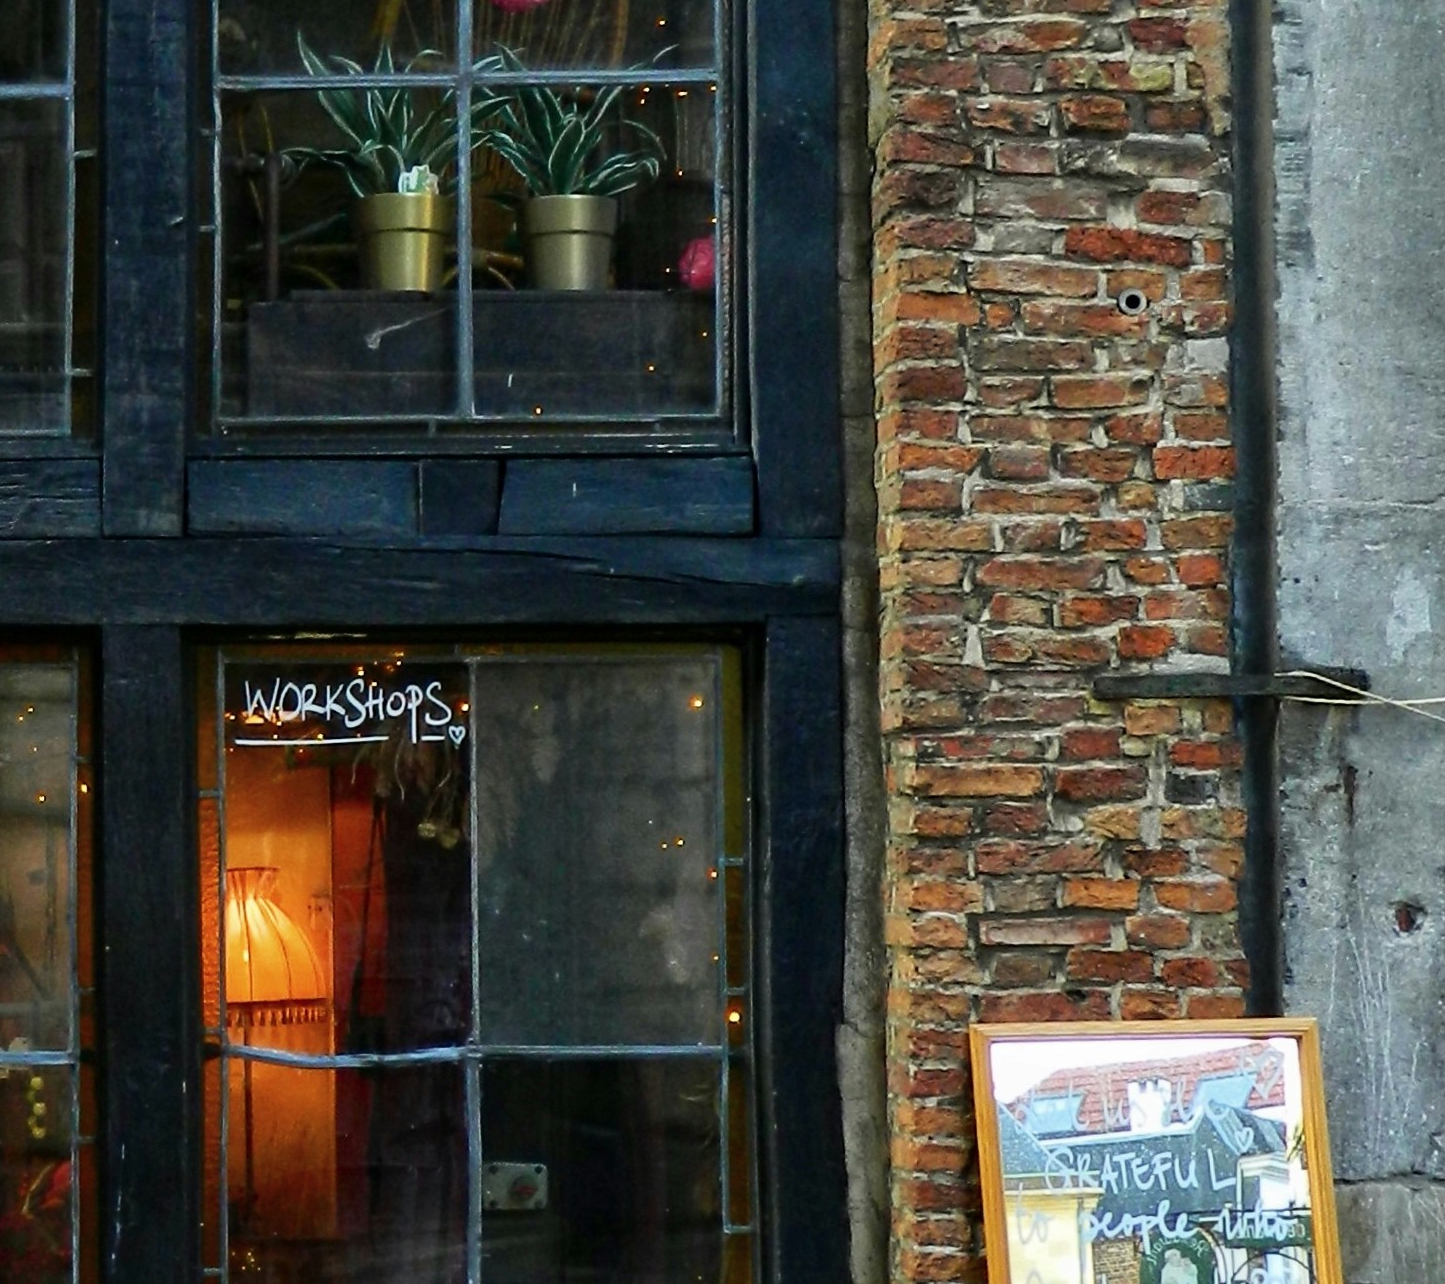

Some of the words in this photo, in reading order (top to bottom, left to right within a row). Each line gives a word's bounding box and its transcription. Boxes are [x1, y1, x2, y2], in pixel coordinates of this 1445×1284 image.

[244, 677, 452, 744] WORKSHOPS
[1044, 1145, 1239, 1195] GRATEFUL
[1015, 1183, 1055, 1245] to
[1079, 1199, 1201, 1258] people
[1212, 1199, 1298, 1241] who
